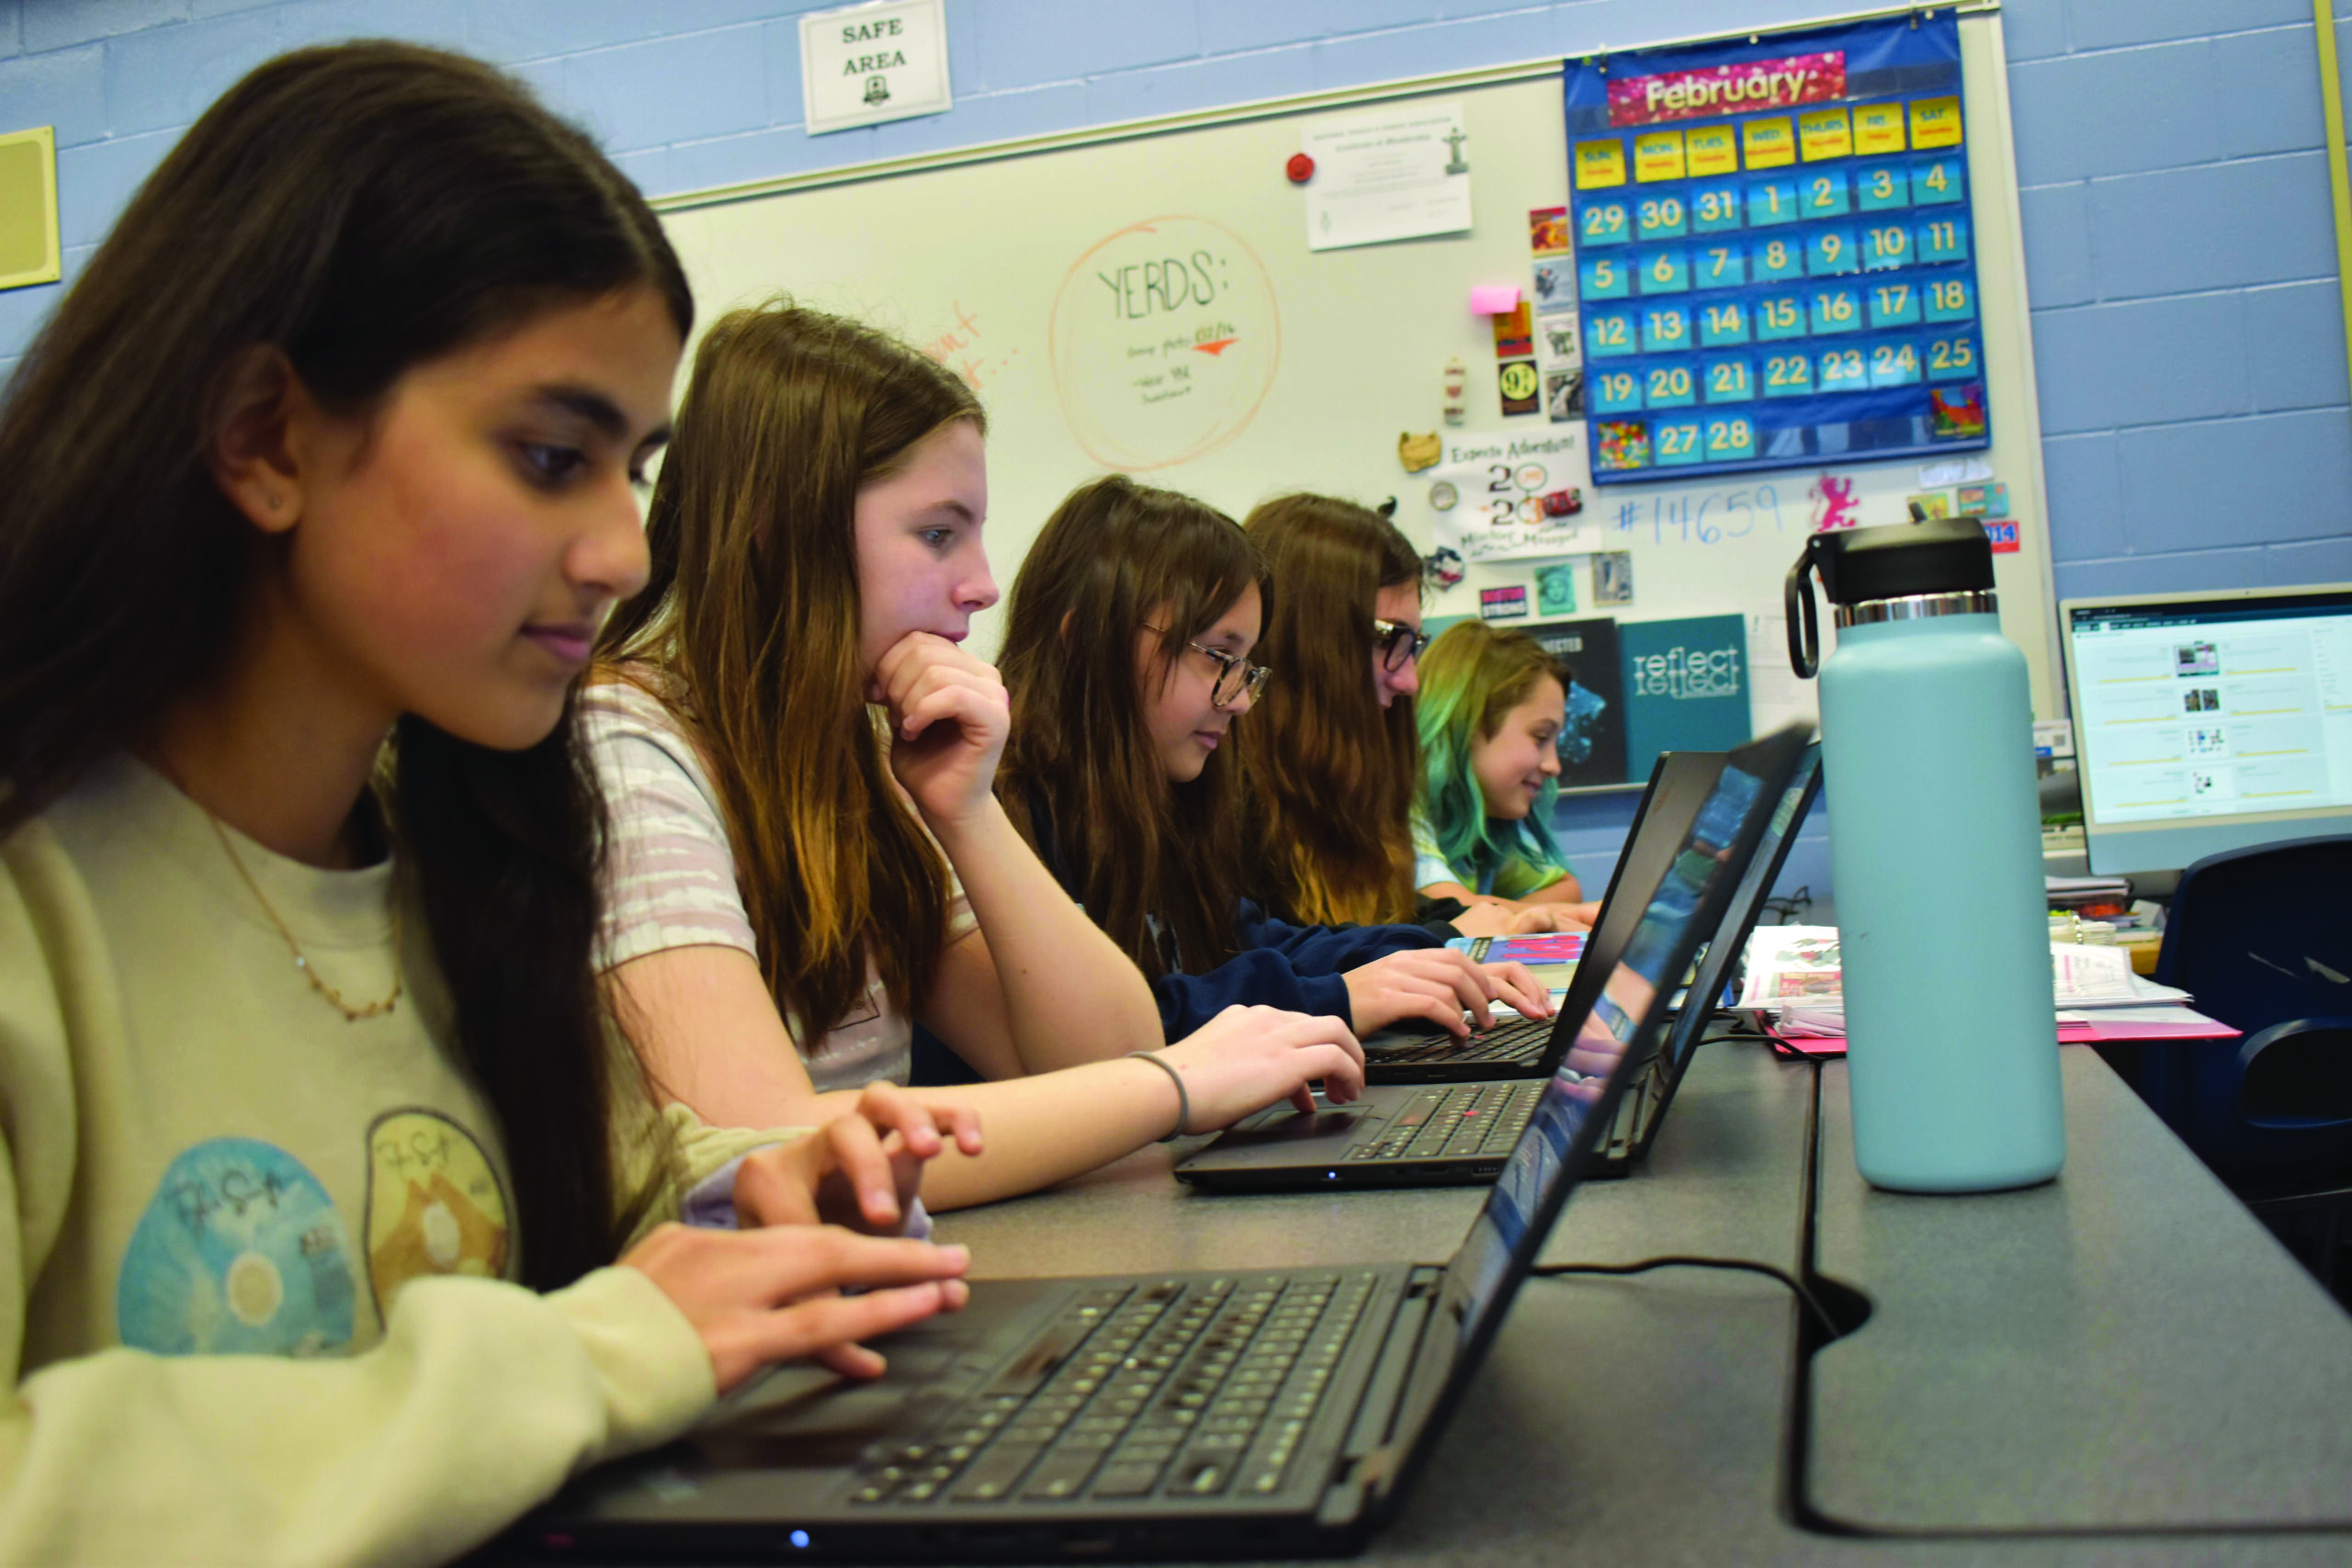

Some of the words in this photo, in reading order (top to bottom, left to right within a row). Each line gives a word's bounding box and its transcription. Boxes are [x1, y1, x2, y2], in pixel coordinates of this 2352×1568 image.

[842, 18, 903, 44] SAFE
[842, 50, 906, 75] AREA
[1645, 67, 1807, 112] February
[1584, 205, 1624, 236] 29
[1640, 198, 1682, 231] 30
[1699, 191, 1734, 221] 31
[1765, 186, 1780, 214] 1
[1812, 177, 1833, 207] 2
[1872, 170, 1894, 199] 3
[1926, 164, 1948, 193] 4
[1098, 250, 1228, 319] YERDS:
[1594, 260, 1615, 289] 5
[1653, 254, 1675, 283] 6
[1708, 248, 1729, 276] 7
[1765, 242, 1788, 271] 8
[1820, 234, 1842, 264] 9
[1869, 226, 1905, 256] 10
[1928, 221, 1955, 250] 11
[1593, 317, 1628, 346] 12
[1648, 311, 1683, 342] 13
[1707, 305, 1741, 334] 14
[1762, 299, 1797, 330] 15
[1817, 293, 1852, 321] 16
[1876, 285, 1910, 316] 17
[1932, 280, 1966, 310] 18
[1600, 373, 1633, 402] 19
[1650, 367, 1690, 397] 20
[1712, 363, 1746, 393] 21
[1767, 355, 1808, 386] 22
[1822, 349, 1864, 381] 23
[1873, 344, 1916, 377] 24
[1931, 338, 1973, 368] 25
[1659, 425, 1700, 456] 27
[1709, 420, 1750, 450] 28
[1611, 485, 1784, 545] #14659
[1633, 644, 1739, 676] reflect
